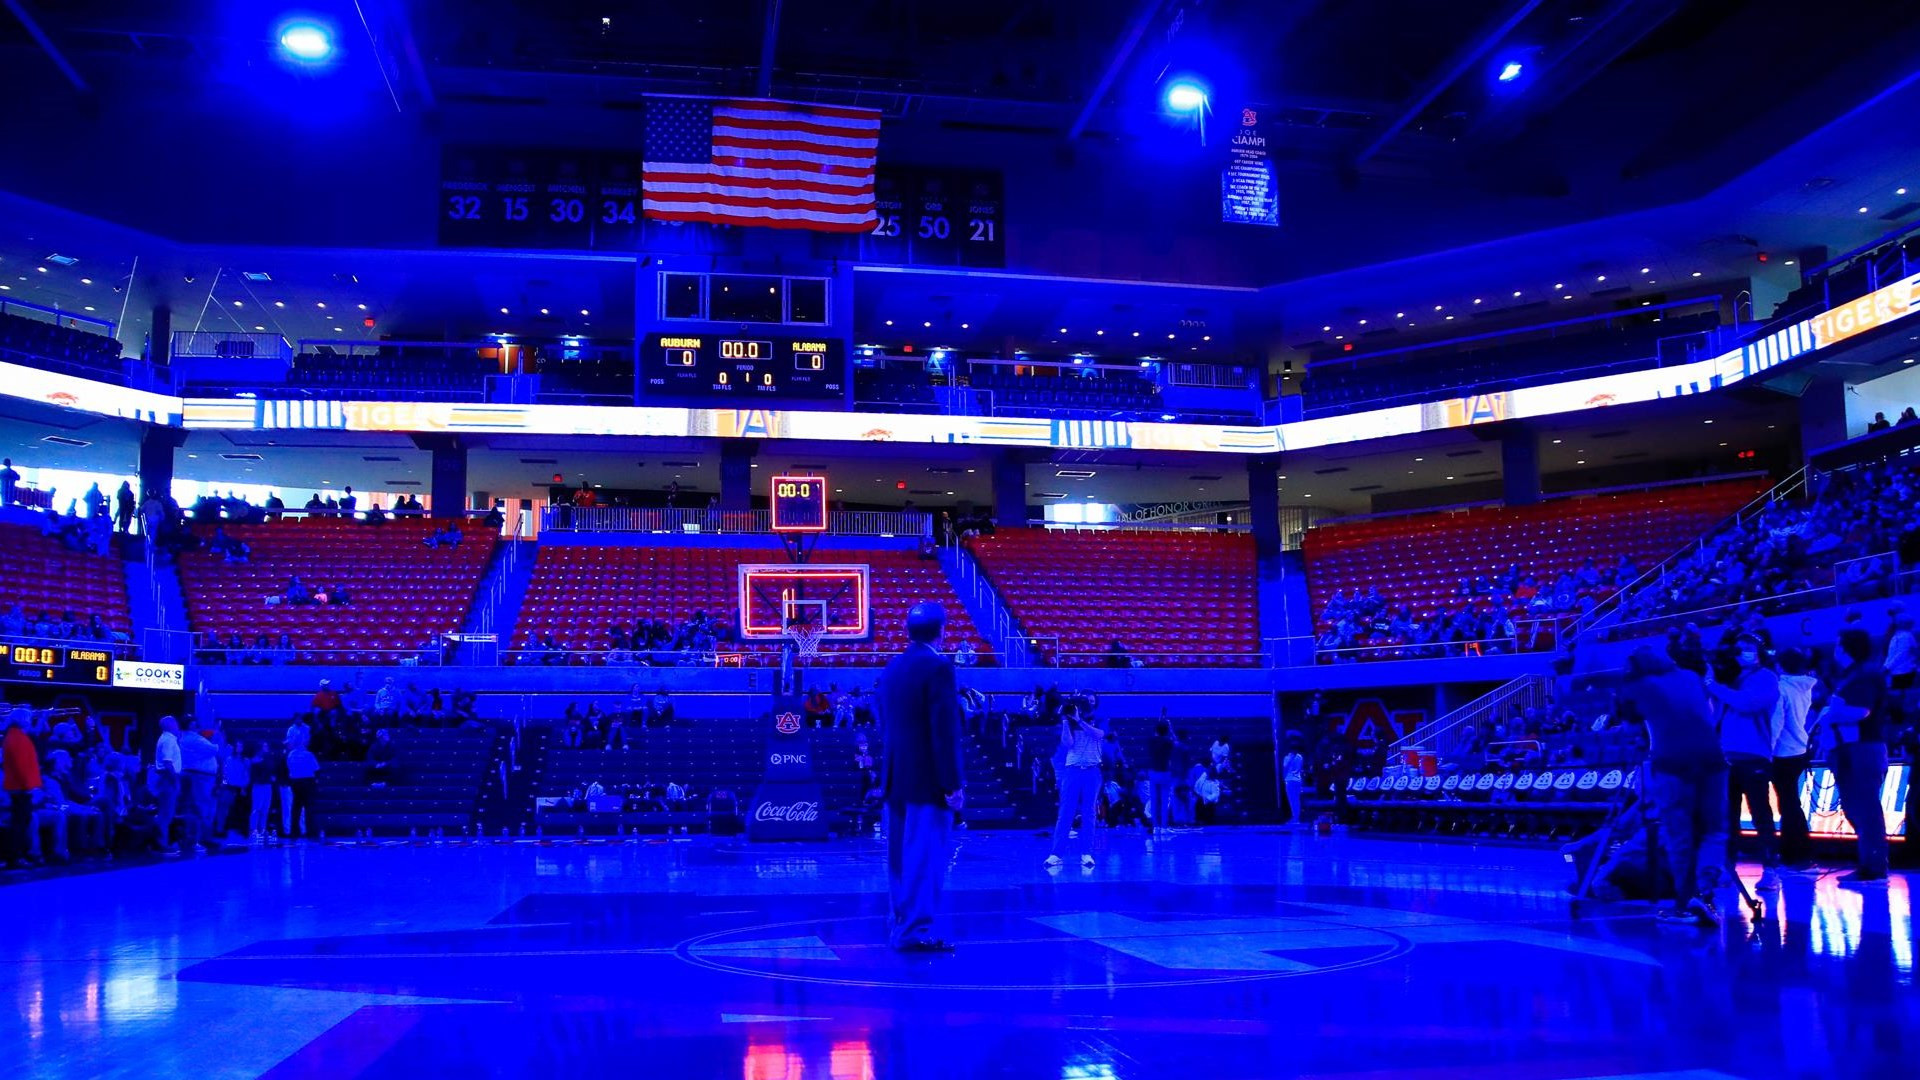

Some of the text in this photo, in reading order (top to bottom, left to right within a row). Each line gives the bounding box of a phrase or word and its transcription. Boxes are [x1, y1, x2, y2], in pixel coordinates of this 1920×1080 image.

[1231, 135, 1266, 148] CIAMPI
[448, 195, 481, 220] 32
[503, 197, 529, 221] 15
[550, 198, 585, 223] 30
[601, 200, 637, 224] 34
[871, 217, 901, 238] 25
[918, 216, 951, 239] 50
[969, 219, 995, 242] 21
[660, 338, 701, 348] AUBURN
[722, 341, 759, 359] 00.0
[792, 342, 826, 353] ALABAMA
[682, 350, 692, 365] 0
[811, 354, 821, 369] 0
[719, 372, 727, 384] 0
[764, 373, 772, 385] 0
[778, 483, 810, 498] 00.0
[1135, 510, 1148, 519] OF
[1148, 502, 1190, 516] HONOR
[14, 647, 54, 664] 00.0
[71, 650, 106, 661] ALABAMA
[96, 666, 108, 681] 0
[136, 667, 182, 679] COOK'S
[783, 754, 807, 764] PNC
[755, 801, 819, 822] Coca-Cola
